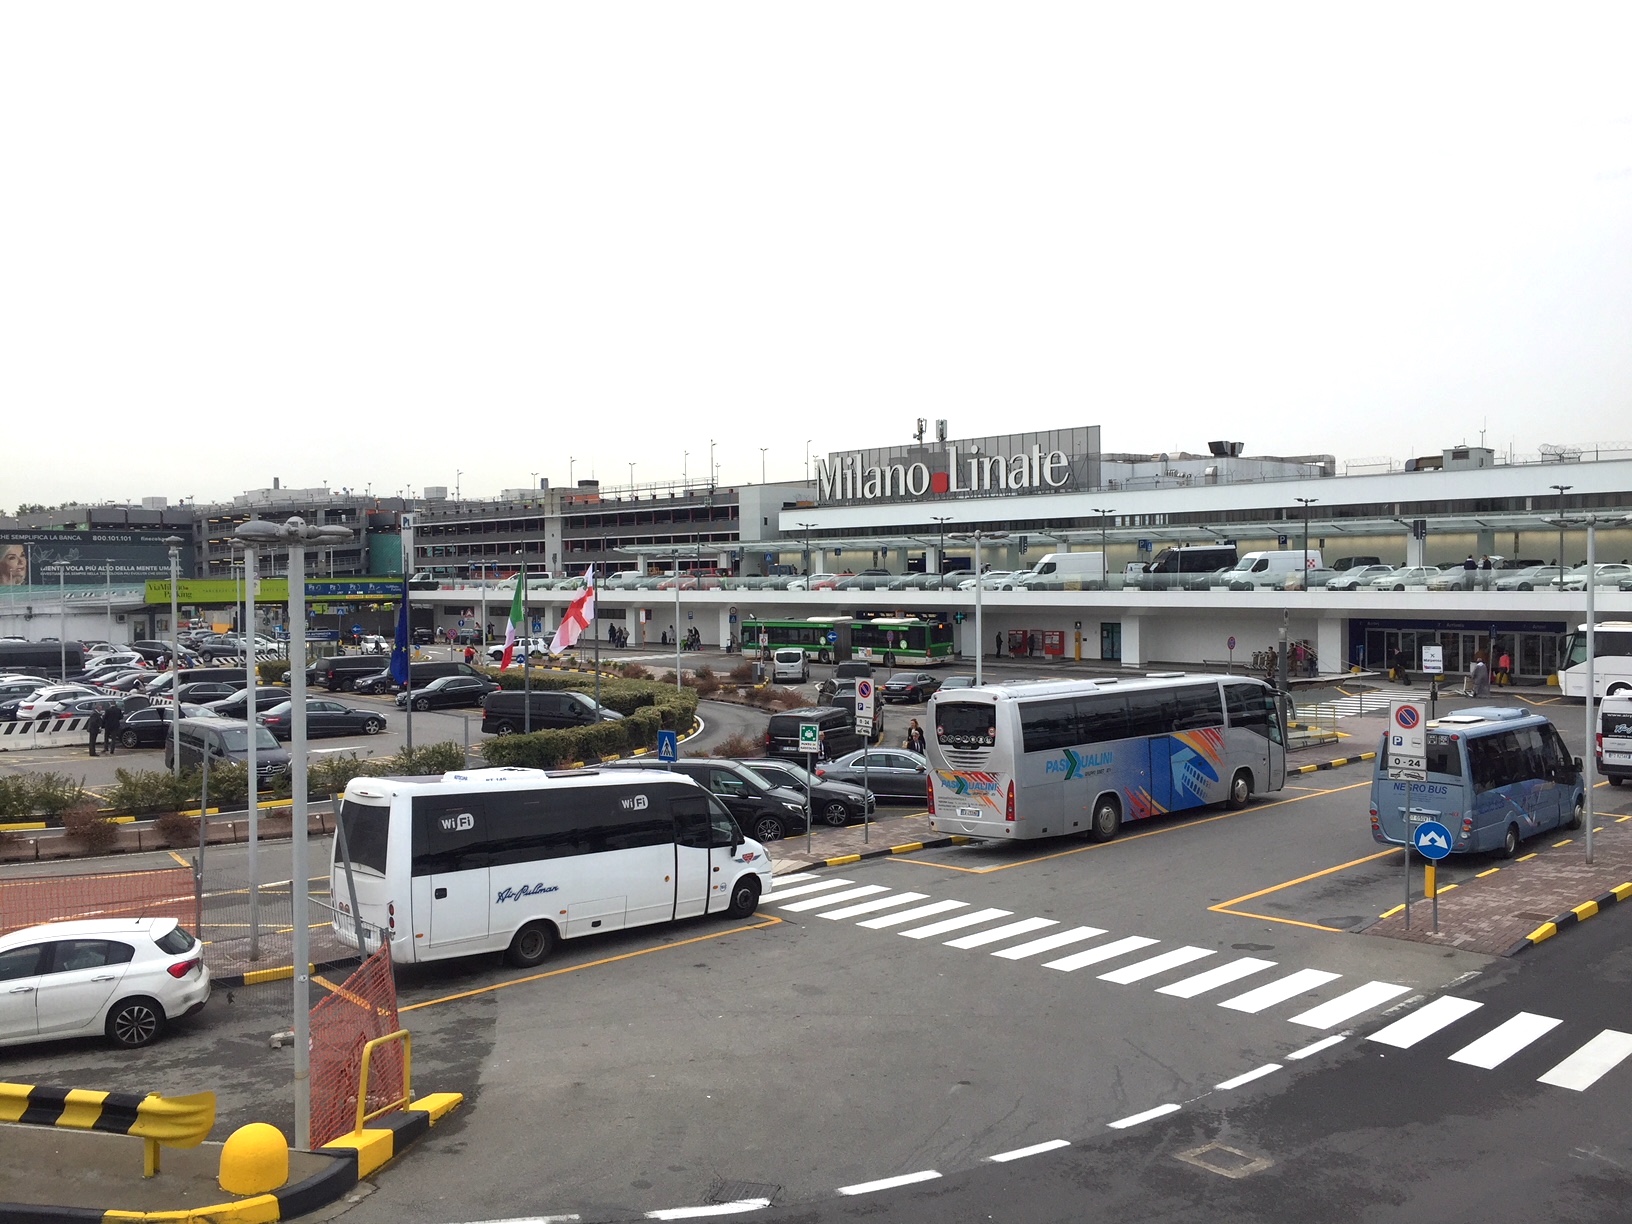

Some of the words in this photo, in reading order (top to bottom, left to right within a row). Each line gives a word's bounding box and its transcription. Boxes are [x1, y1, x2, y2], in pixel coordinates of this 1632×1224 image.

[816, 453, 930, 500] Milano
[946, 443, 1071, 492] Linate
[1394, 757, 1401, 766] 0
[1408, 759, 1421, 767] 24
[1427, 785, 1448, 795] BUS
